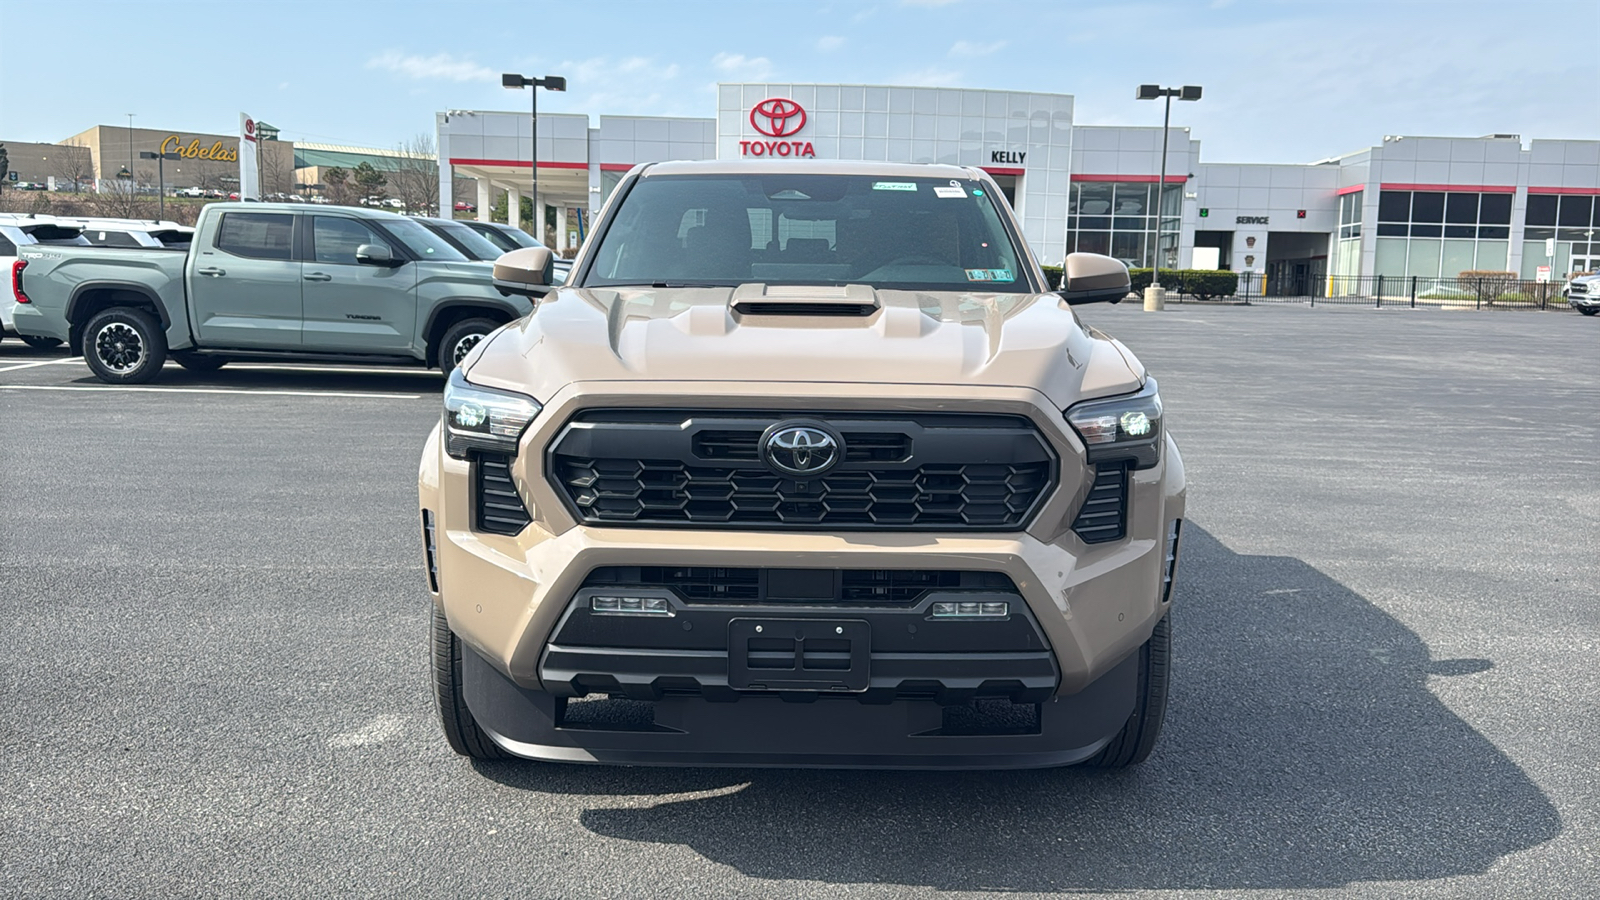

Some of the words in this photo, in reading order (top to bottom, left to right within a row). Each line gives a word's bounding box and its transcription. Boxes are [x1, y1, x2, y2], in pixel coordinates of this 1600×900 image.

[160, 134, 237, 162] Cabela's
[739, 140, 816, 157] TOYOTA
[991, 150, 1027, 164] KELLY
[1235, 215, 1270, 225] SERVICE
[345, 313, 382, 321] TUNDRA
